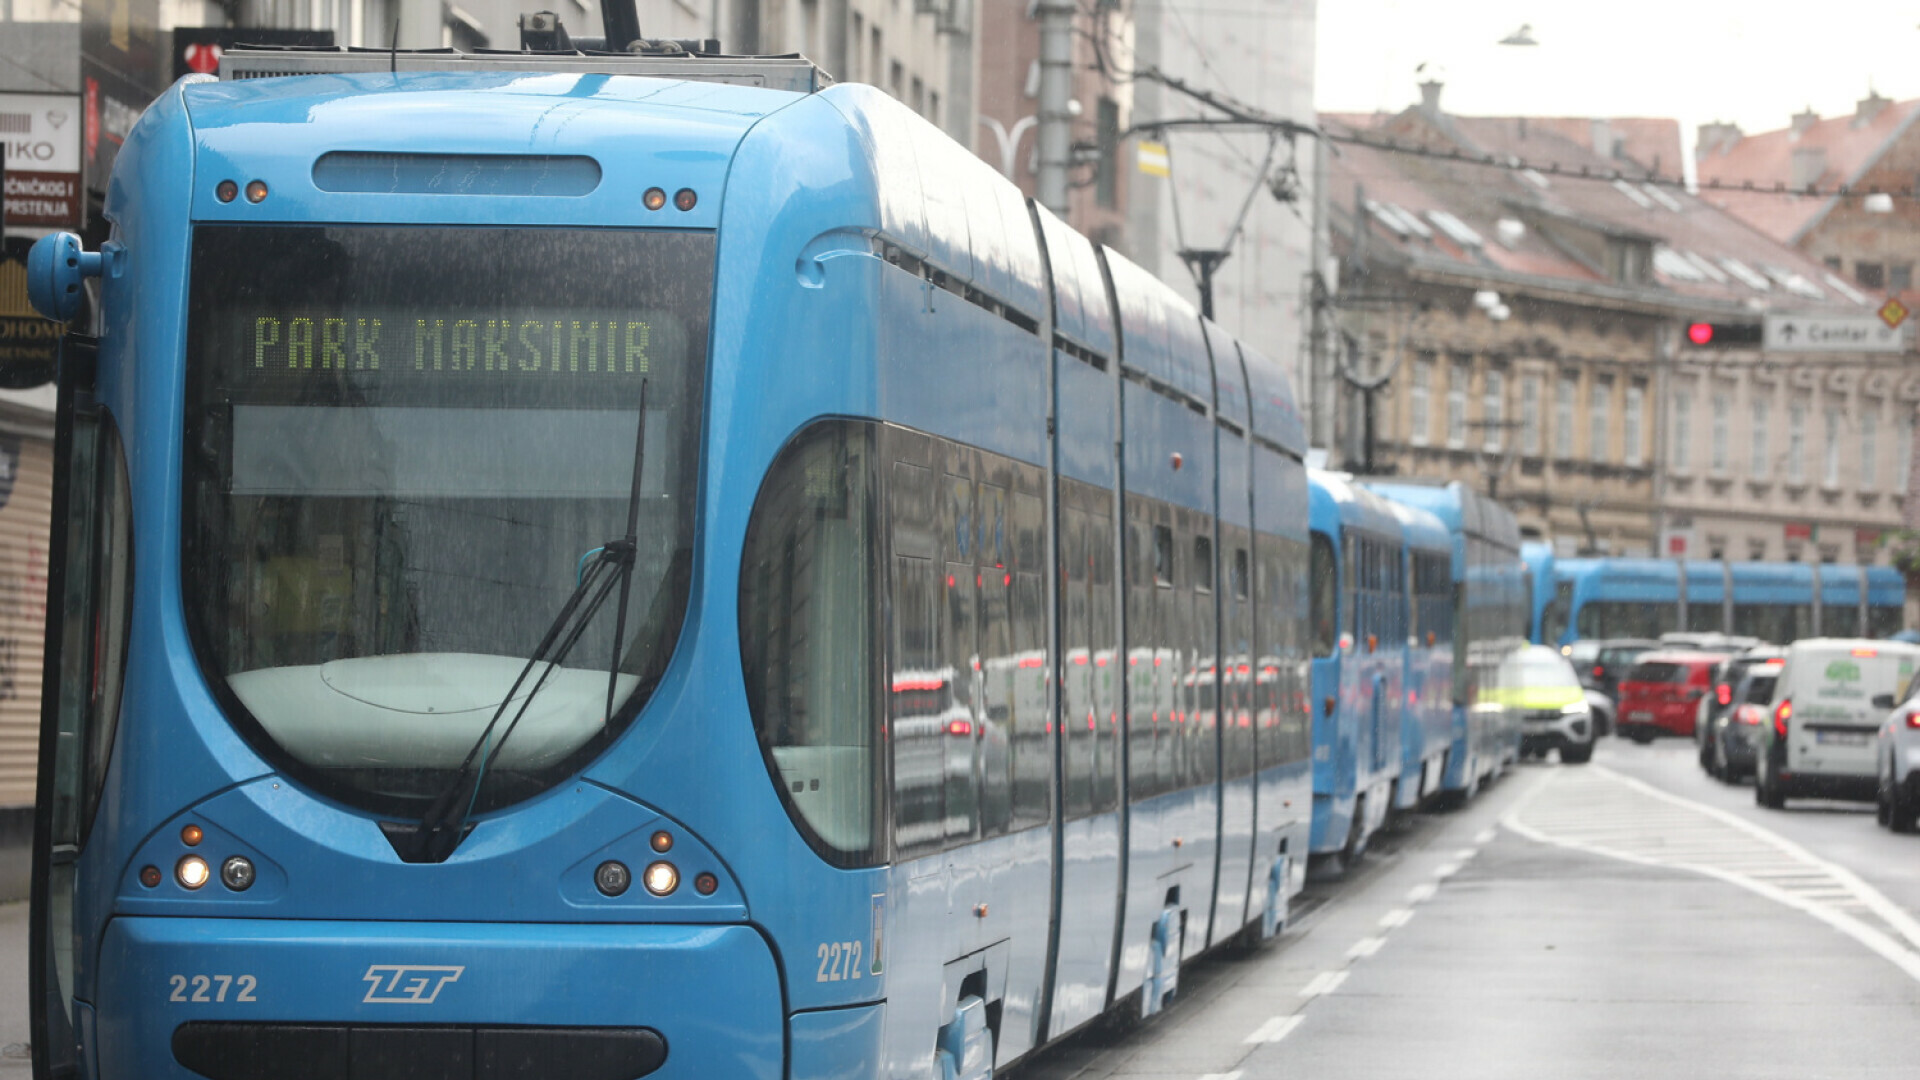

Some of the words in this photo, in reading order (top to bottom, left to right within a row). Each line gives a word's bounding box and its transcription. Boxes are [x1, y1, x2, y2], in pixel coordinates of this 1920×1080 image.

[255, 316, 382, 369] PARK
[415, 318, 651, 373] MAKSIMIR
[816, 940, 862, 983] 2272
[169, 974, 257, 1003] 2272
[362, 964, 466, 1004] ZET
